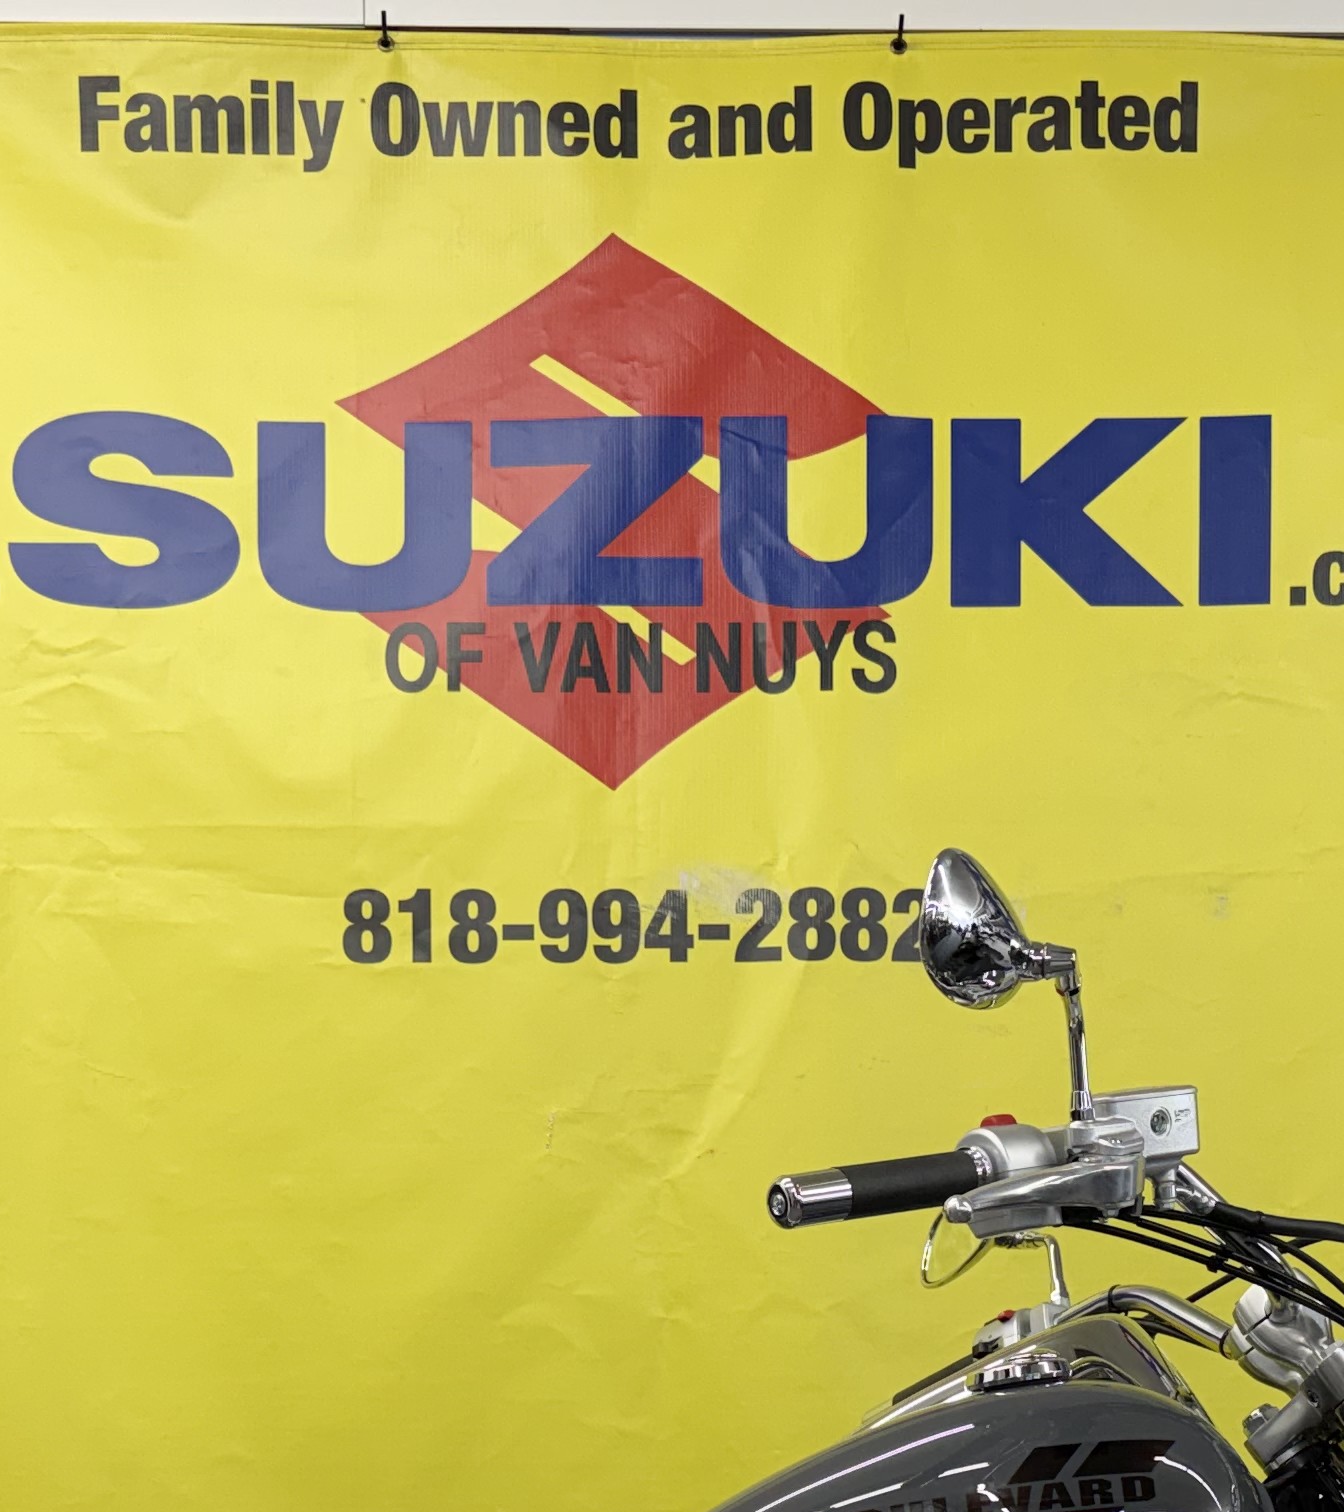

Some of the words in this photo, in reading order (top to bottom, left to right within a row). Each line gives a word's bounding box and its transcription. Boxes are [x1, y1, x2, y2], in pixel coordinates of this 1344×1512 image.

[78, 75, 344, 172] Family
[370, 82, 639, 159] Owned
[667, 85, 813, 159] and
[843, 80, 1199, 169] Operated
[384, 621, 486, 694] OF
[515, 620, 664, 694] VAN
[695, 618, 898, 695] NUYS
[341, 886, 923, 964] 818-994-2882
